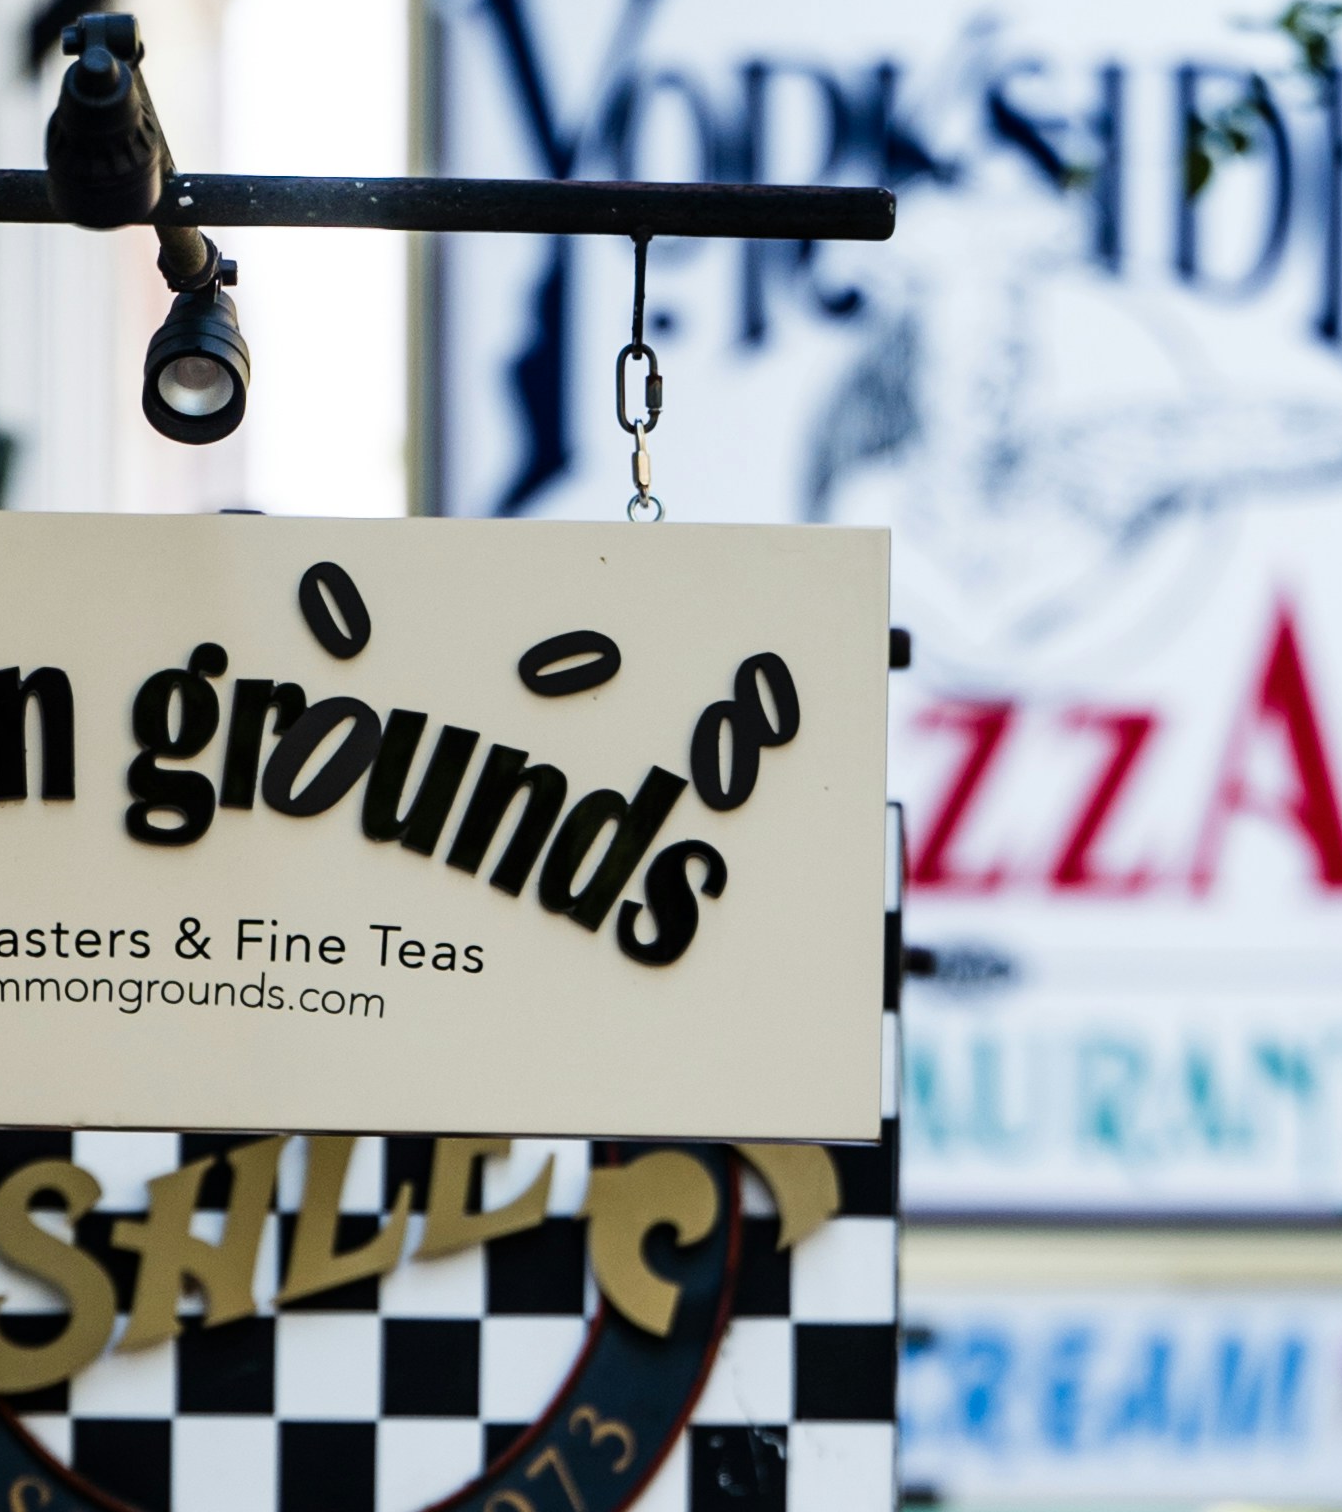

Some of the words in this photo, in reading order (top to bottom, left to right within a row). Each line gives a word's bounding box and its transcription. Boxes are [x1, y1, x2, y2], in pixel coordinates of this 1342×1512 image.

[126, 641, 729, 968] grounds
[175, 916, 211, 961] &
[237, 918, 346, 965] Fine
[369, 924, 485, 974] Teas
